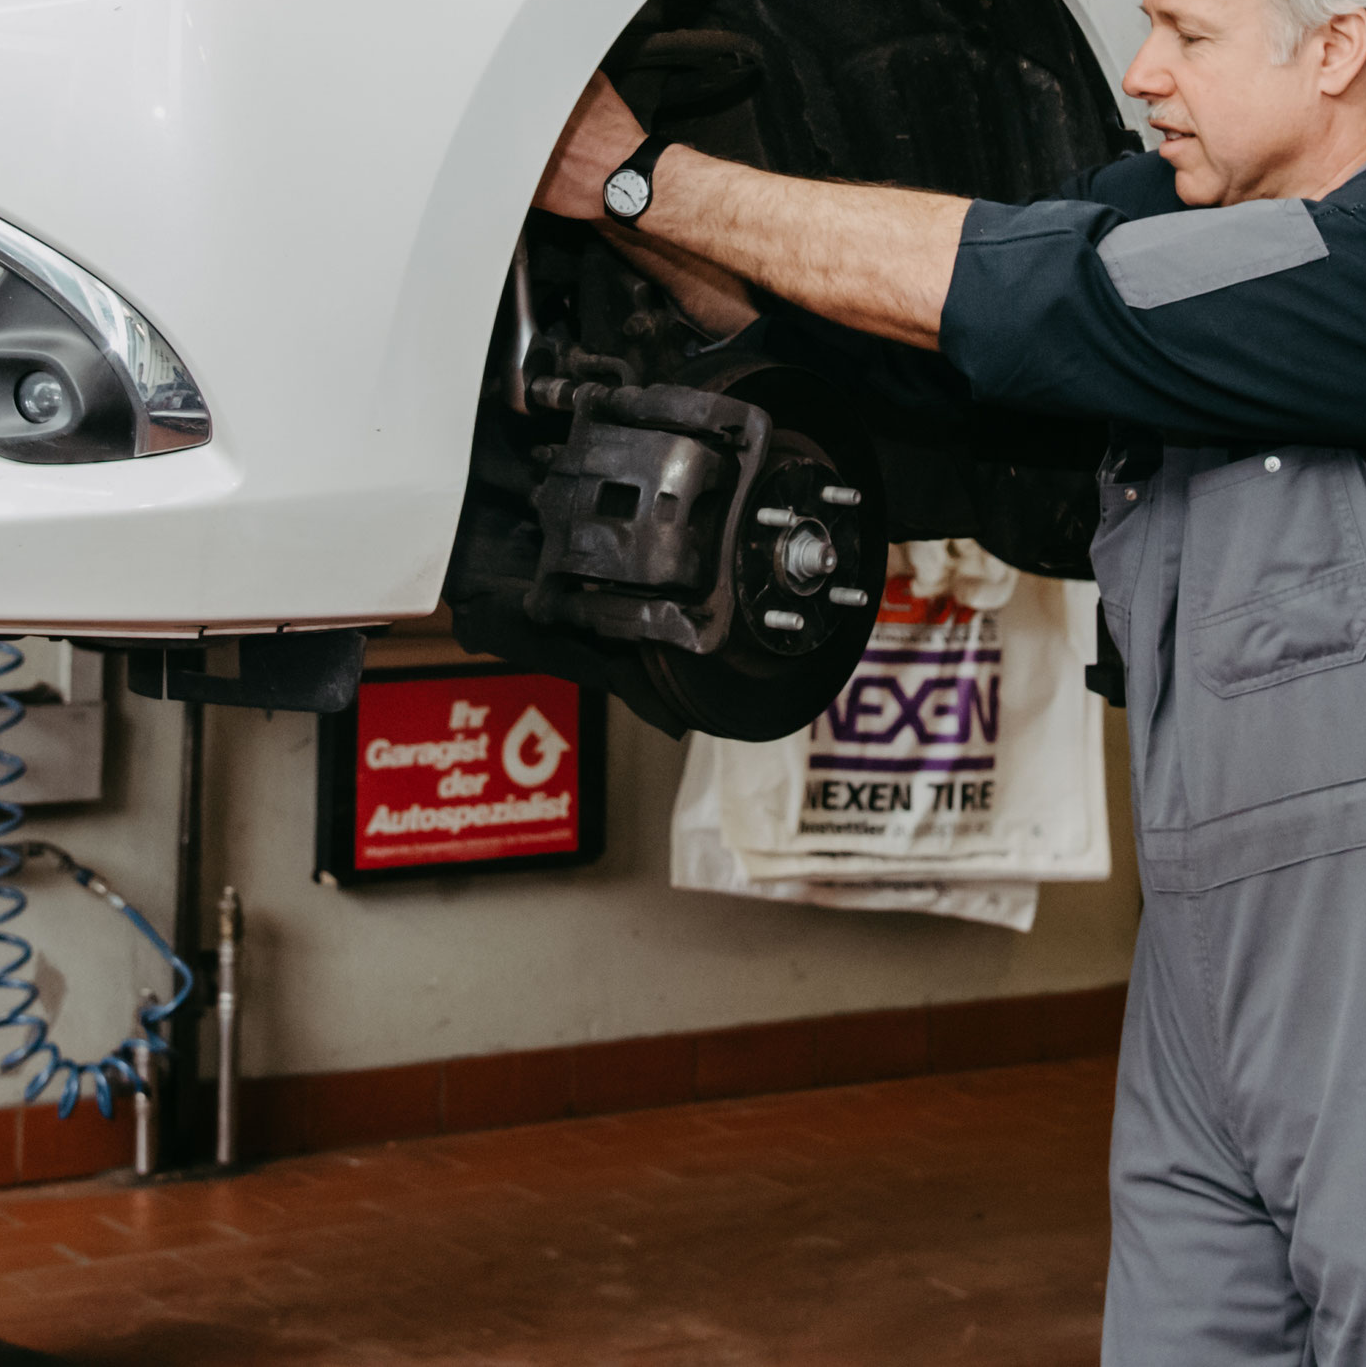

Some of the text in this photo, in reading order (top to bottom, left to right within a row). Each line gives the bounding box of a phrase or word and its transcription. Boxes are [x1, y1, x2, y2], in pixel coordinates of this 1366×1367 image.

[449, 699, 491, 731] Ihr
[365, 732, 490, 771] Garagist
[437, 767, 490, 800] der
[807, 780, 994, 812] NEXEN TIRE
[365, 790, 572, 836] Autospezialist
